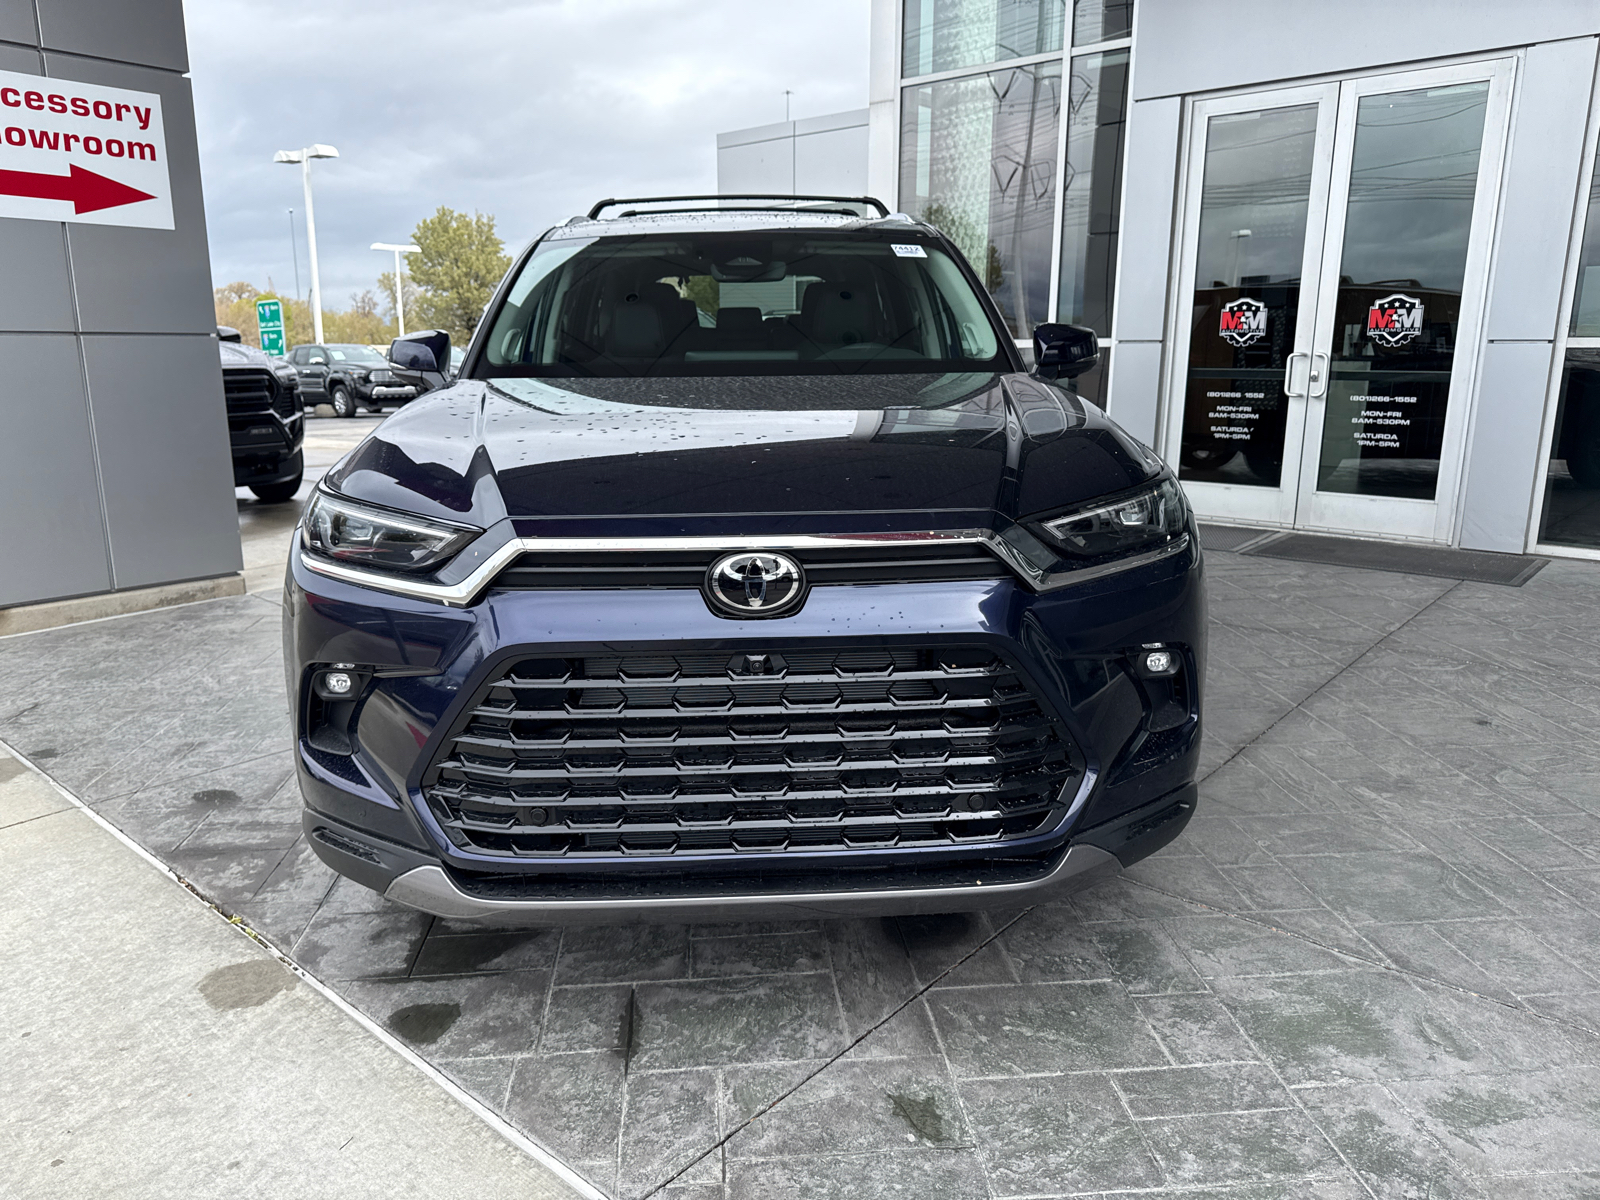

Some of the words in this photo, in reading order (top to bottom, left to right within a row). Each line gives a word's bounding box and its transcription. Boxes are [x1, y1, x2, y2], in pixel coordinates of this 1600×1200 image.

[0, 87, 152, 130] cessory
[0, 126, 157, 162] owroom
[1369, 308, 1422, 328] M&M
[1349, 395, 1417, 403] (801)266-1552
[1360, 410, 1402, 418] MON-FRI
[1356, 440, 1400, 448] 1PM-5PM
